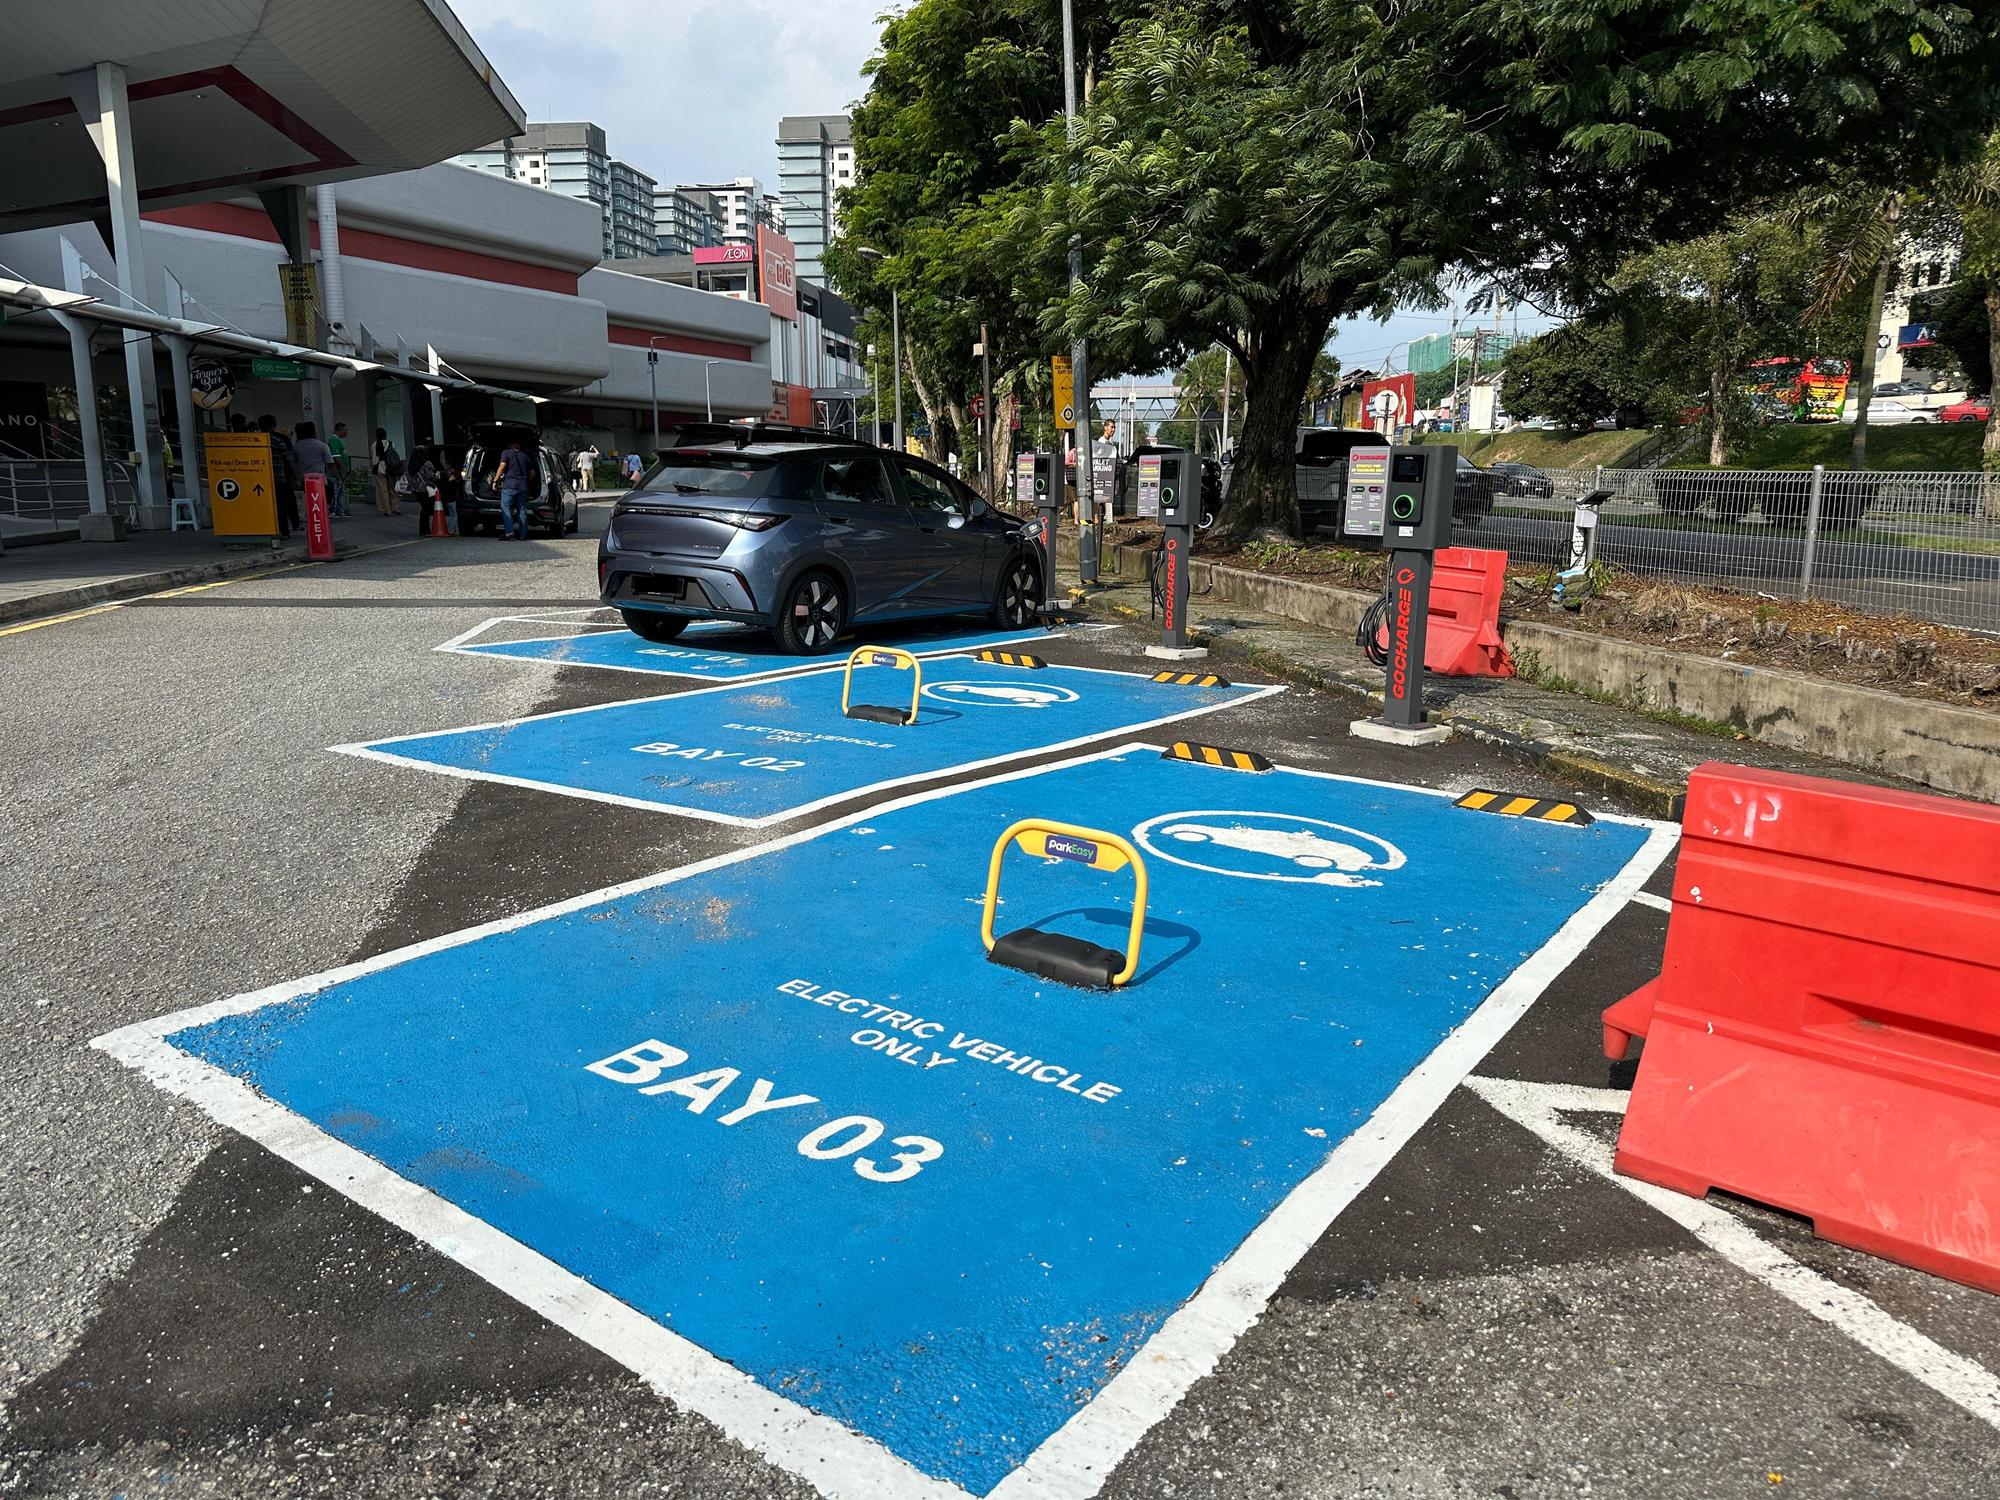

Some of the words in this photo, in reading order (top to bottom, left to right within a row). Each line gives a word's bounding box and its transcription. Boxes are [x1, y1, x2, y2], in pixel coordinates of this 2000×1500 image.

[201, 376, 223, 392] Bar
[311, 492, 322, 543] VALET
[1165, 552, 1176, 631] GOCHARGE
[634, 648, 711, 658] BAY
[1392, 587, 1412, 700] GOCHARGE
[722, 723, 812, 739] ELECTRIC
[814, 733, 897, 749] VEHICLE
[765, 734, 822, 745] ONLY
[630, 742, 746, 761] BAY
[739, 756, 806, 772] 02
[1048, 839, 1094, 859] ParkEasy
[776, 978, 945, 1039] ELECTRIC
[947, 1032, 1123, 1103] VEHICLE
[850, 1028, 958, 1071] ONLY
[583, 1038, 820, 1127] BAY
[797, 1115, 944, 1183] 03
